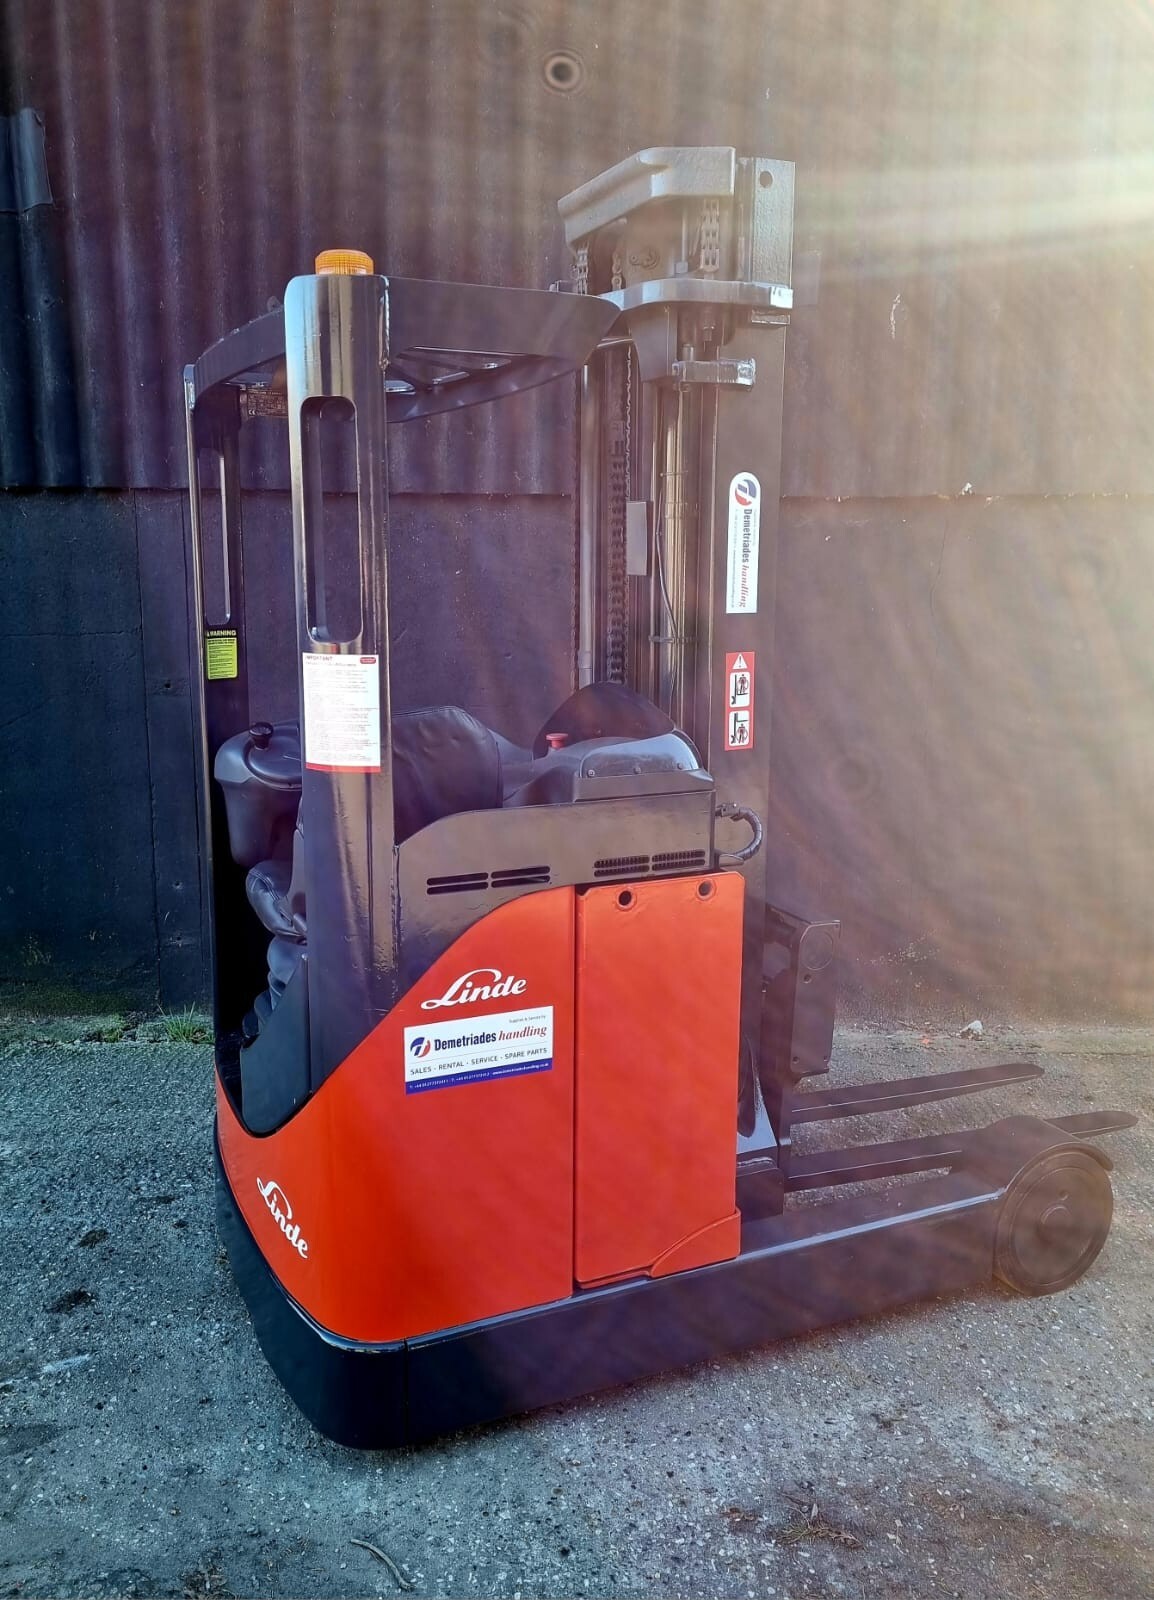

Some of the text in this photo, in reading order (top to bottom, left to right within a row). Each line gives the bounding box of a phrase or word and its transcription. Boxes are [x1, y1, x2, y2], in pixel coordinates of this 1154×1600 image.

[739, 508, 752, 608] Demetriades handling
[209, 629, 237, 637] WARNING
[420, 968, 527, 1010] Linde
[434, 1025, 548, 1051] Demetriades handling
[410, 1047, 548, 1076] SALES RENTAL SERVICE SPARE PARTS
[256, 1176, 308, 1259] Linde
